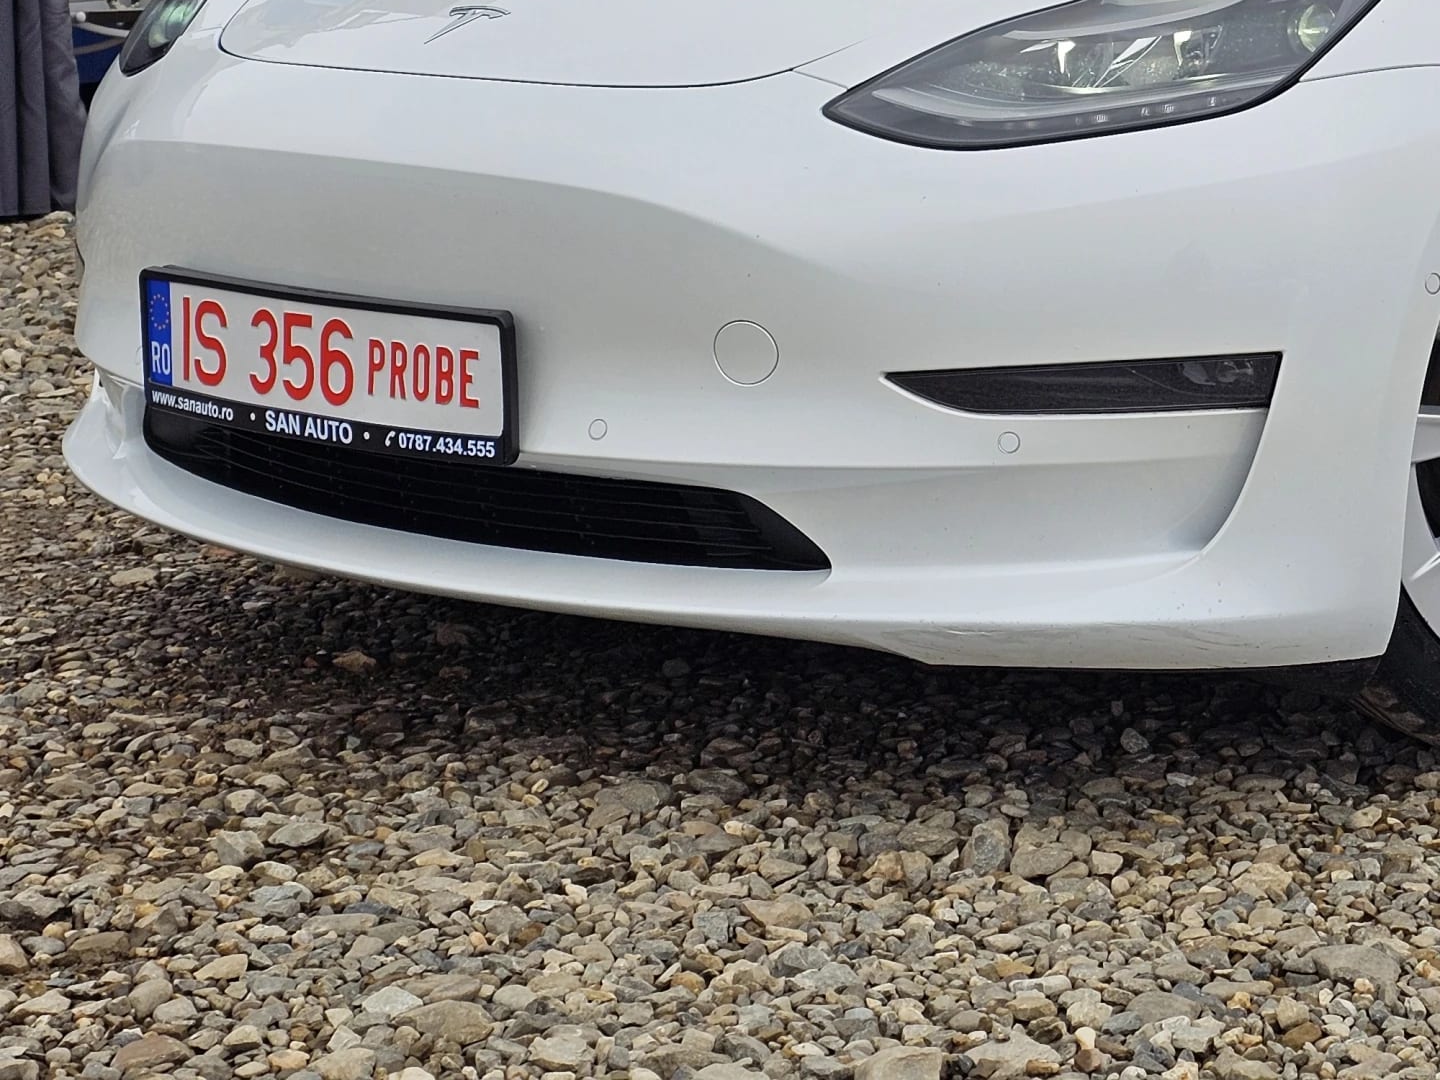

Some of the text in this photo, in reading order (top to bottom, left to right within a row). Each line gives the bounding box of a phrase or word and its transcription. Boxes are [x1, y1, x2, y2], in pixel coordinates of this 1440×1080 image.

[151, 340, 171, 376] RO
[182, 296, 481, 409] IS 356 PROBE
[151, 388, 234, 421] www.sanauto.ro
[264, 409, 353, 445] SAN AUTO
[397, 431, 496, 459] 0787.434.555
